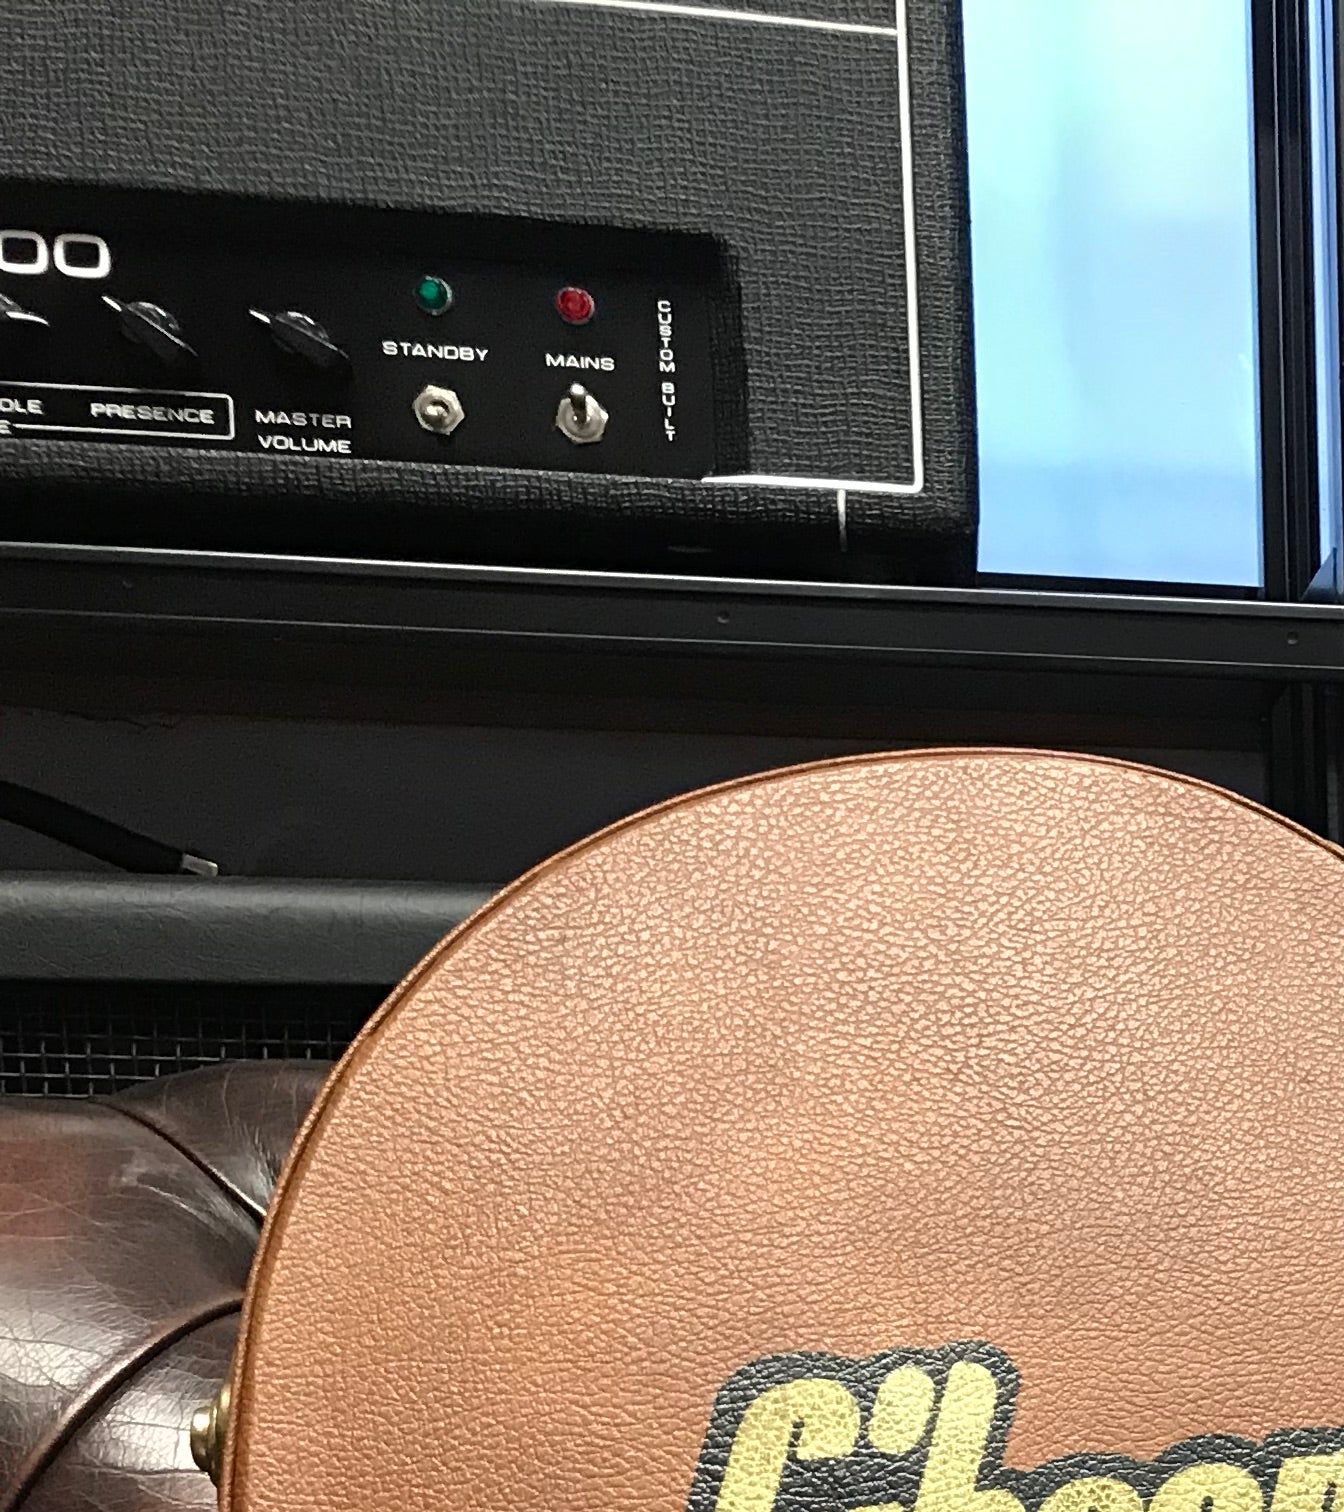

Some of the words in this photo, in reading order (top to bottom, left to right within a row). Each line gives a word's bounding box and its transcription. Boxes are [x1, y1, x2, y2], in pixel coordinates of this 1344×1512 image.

[657, 300, 676, 373] CUSTOM
[382, 340, 489, 361] STANDBY
[545, 353, 616, 371] MAINS
[90, 402, 215, 424] PRESENCE
[255, 409, 352, 429] MASTER
[661, 381, 676, 441] BUILT
[258, 434, 352, 454] VOLUME
